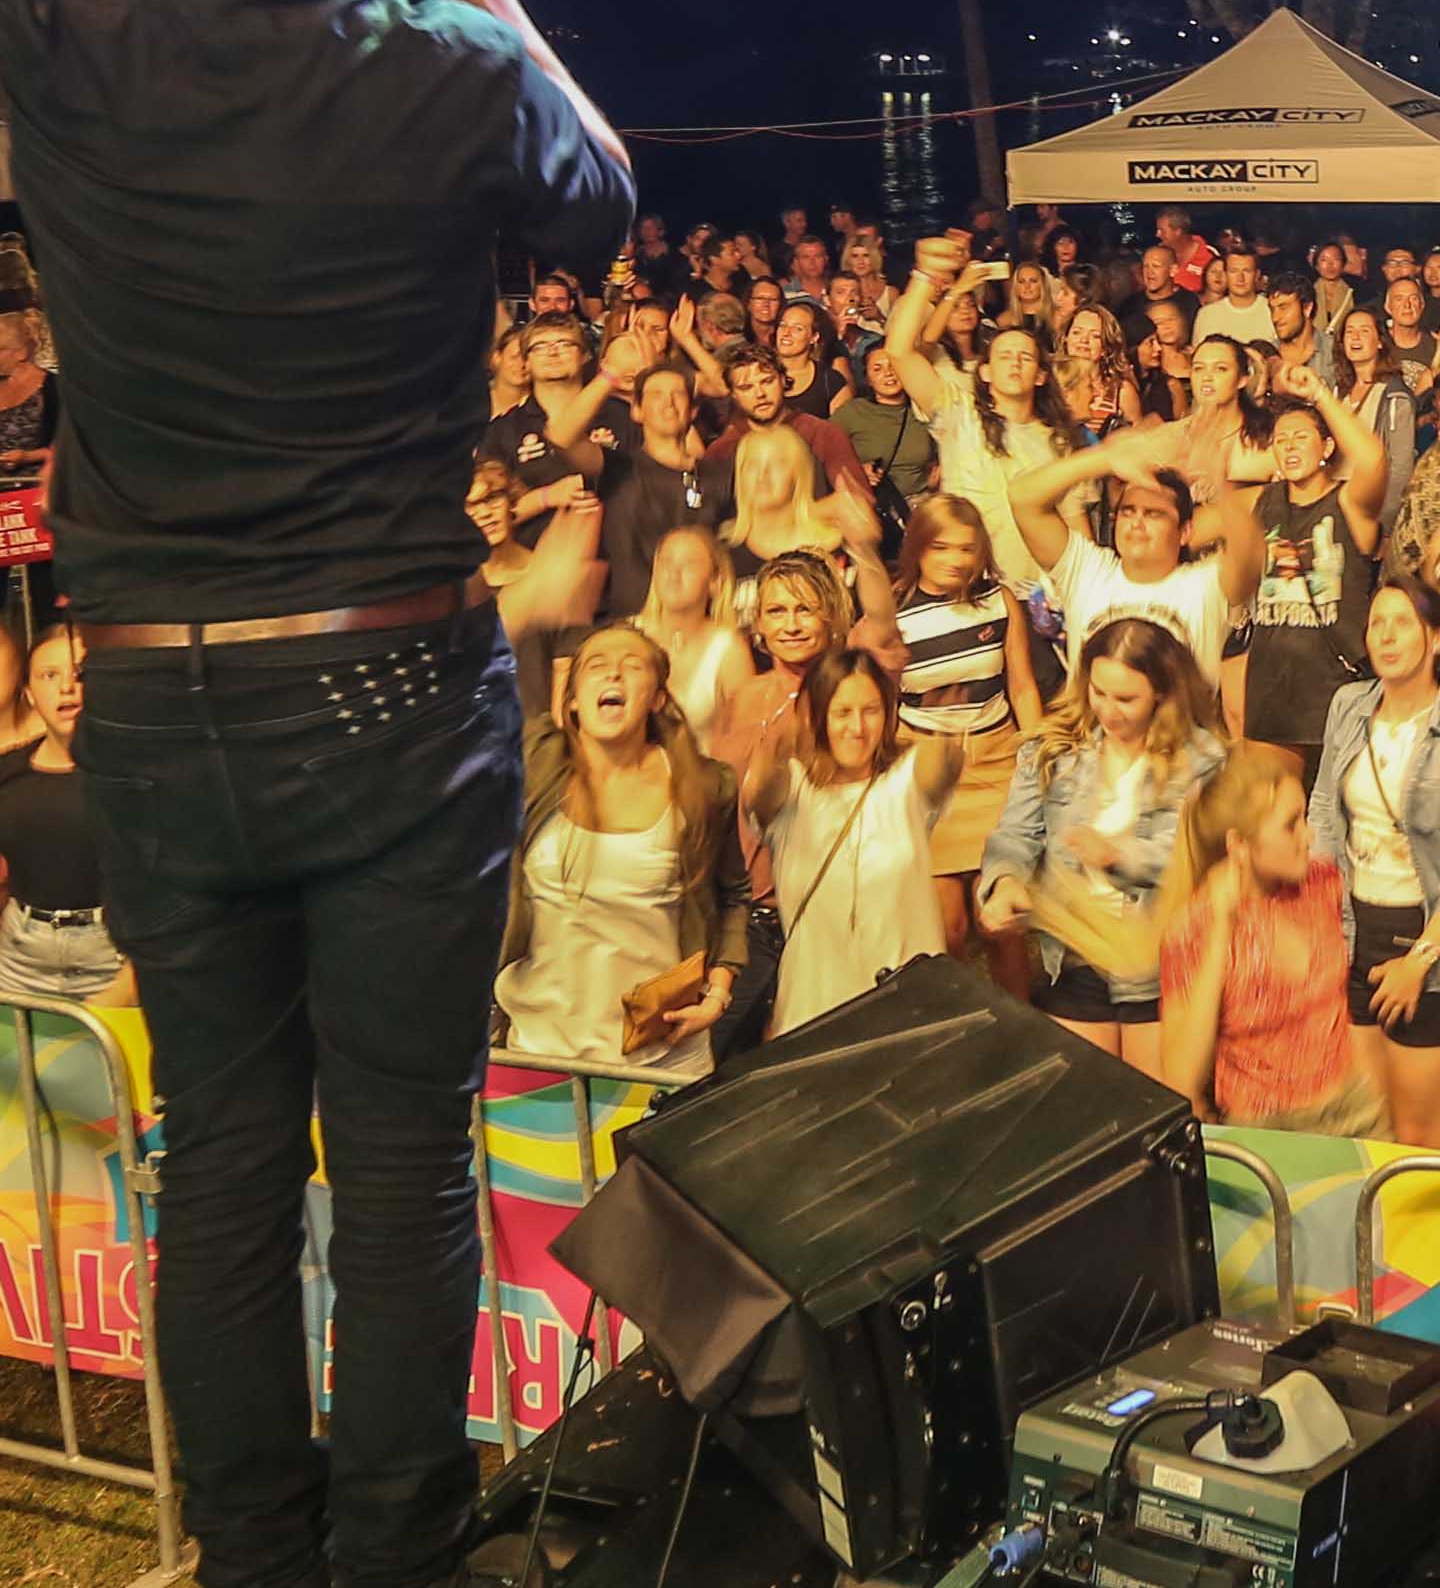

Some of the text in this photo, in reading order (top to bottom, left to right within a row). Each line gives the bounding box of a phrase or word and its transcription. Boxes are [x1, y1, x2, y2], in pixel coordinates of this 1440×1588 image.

[1136, 109, 1275, 127] MACKAY
[1133, 163, 1244, 180] MACKAY
[1187, 185, 1258, 194] AUTO GROUP
